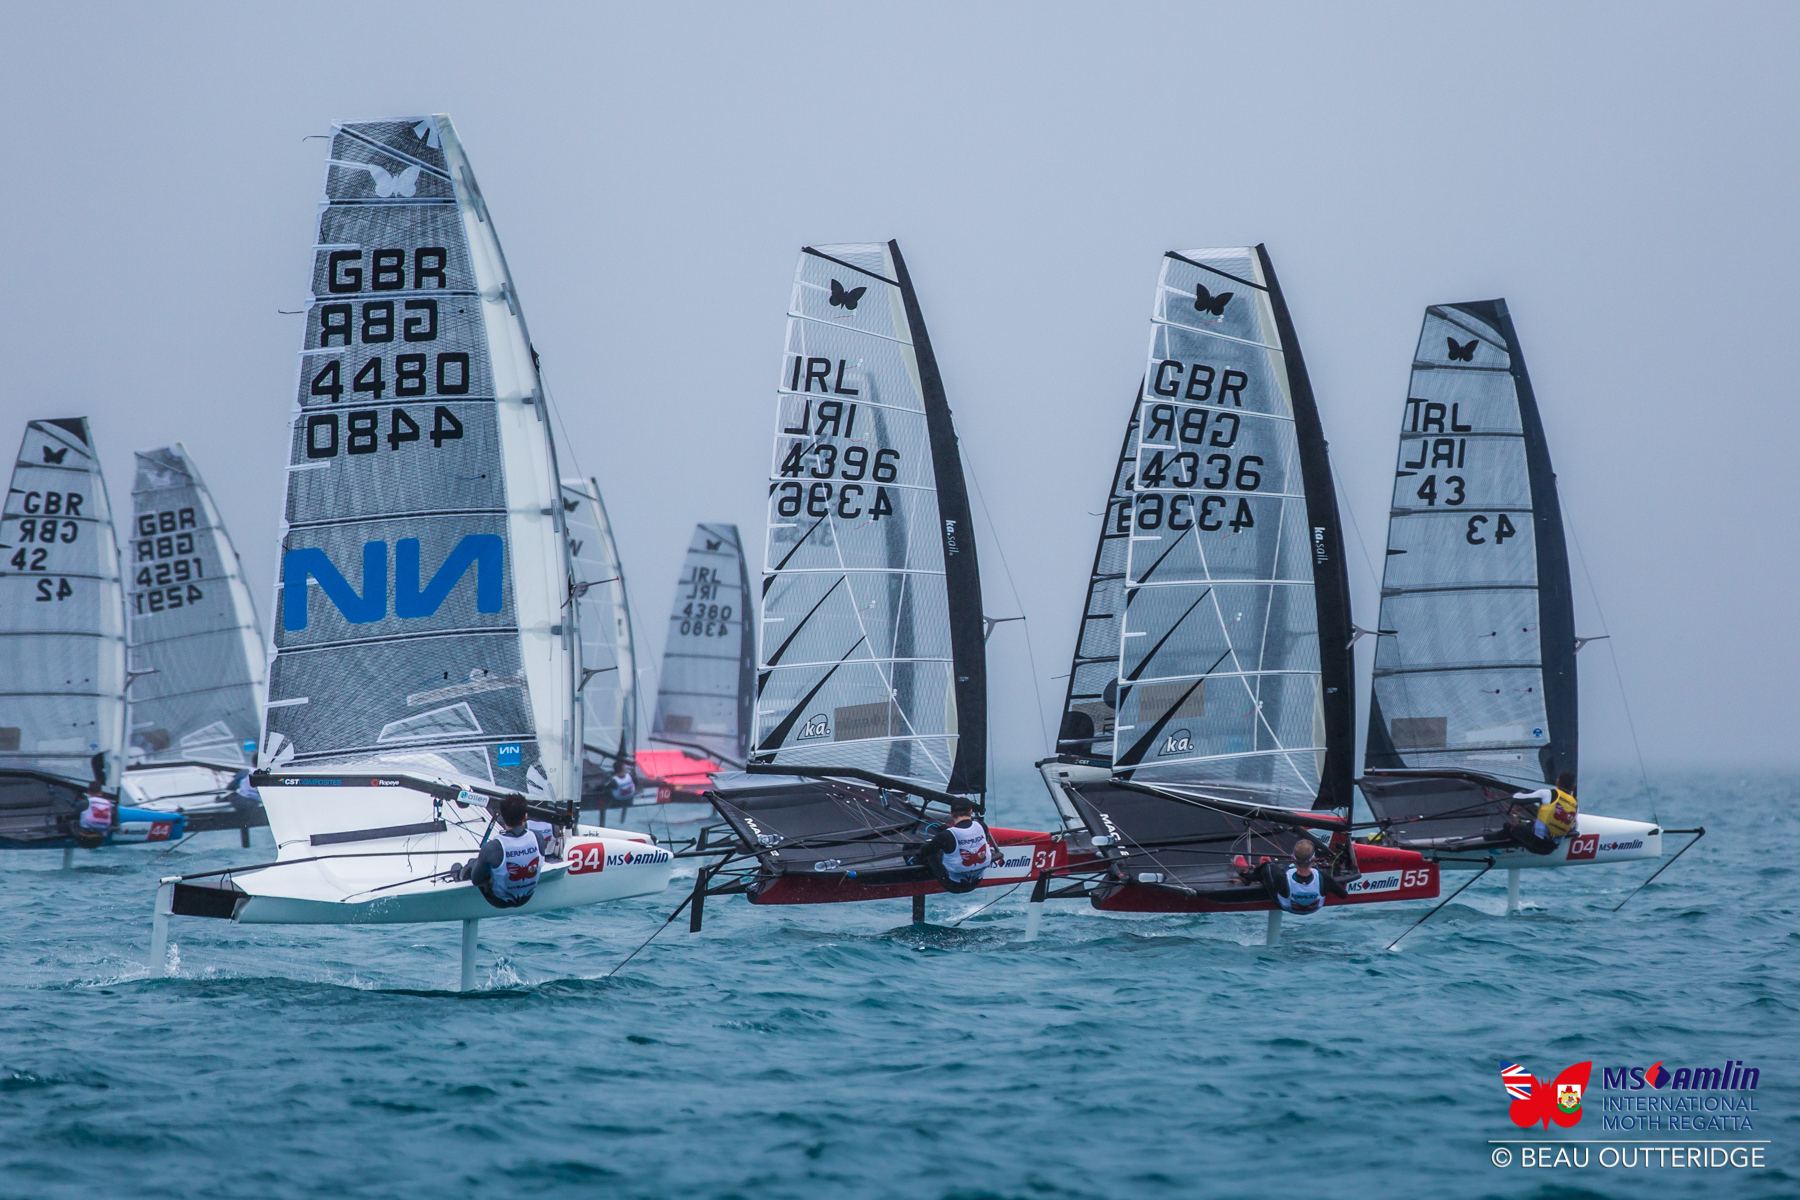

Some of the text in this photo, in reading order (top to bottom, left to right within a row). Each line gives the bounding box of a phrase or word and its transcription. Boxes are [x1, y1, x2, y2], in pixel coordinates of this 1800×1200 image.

[328, 247, 447, 293] GBR
[311, 352, 470, 403] 4480
[791, 355, 859, 395] IRL
[1154, 359, 1248, 407] GBR
[1411, 401, 1472, 433] IRL
[781, 443, 900, 483] 4396
[1142, 451, 1264, 491] 4336
[1416, 475, 1466, 506] 43
[24, 491, 83, 516] GBR
[138, 507, 197, 537] GBR
[10, 547, 48, 571] 42
[136, 557, 203, 588] 4291
[691, 566, 722, 584] IRL
[683, 602, 733, 620] 4380
[467, 793, 488, 805] allen
[150, 825, 171, 836] 44
[505, 846, 538, 858] BERMUDA
[1034, 850, 1057, 868] 31
[1571, 839, 1595, 854] 04
[568, 847, 600, 872] 34
[606, 854, 624, 866] MS
[1347, 882, 1362, 892] MS
[1403, 868, 1430, 888] 55
